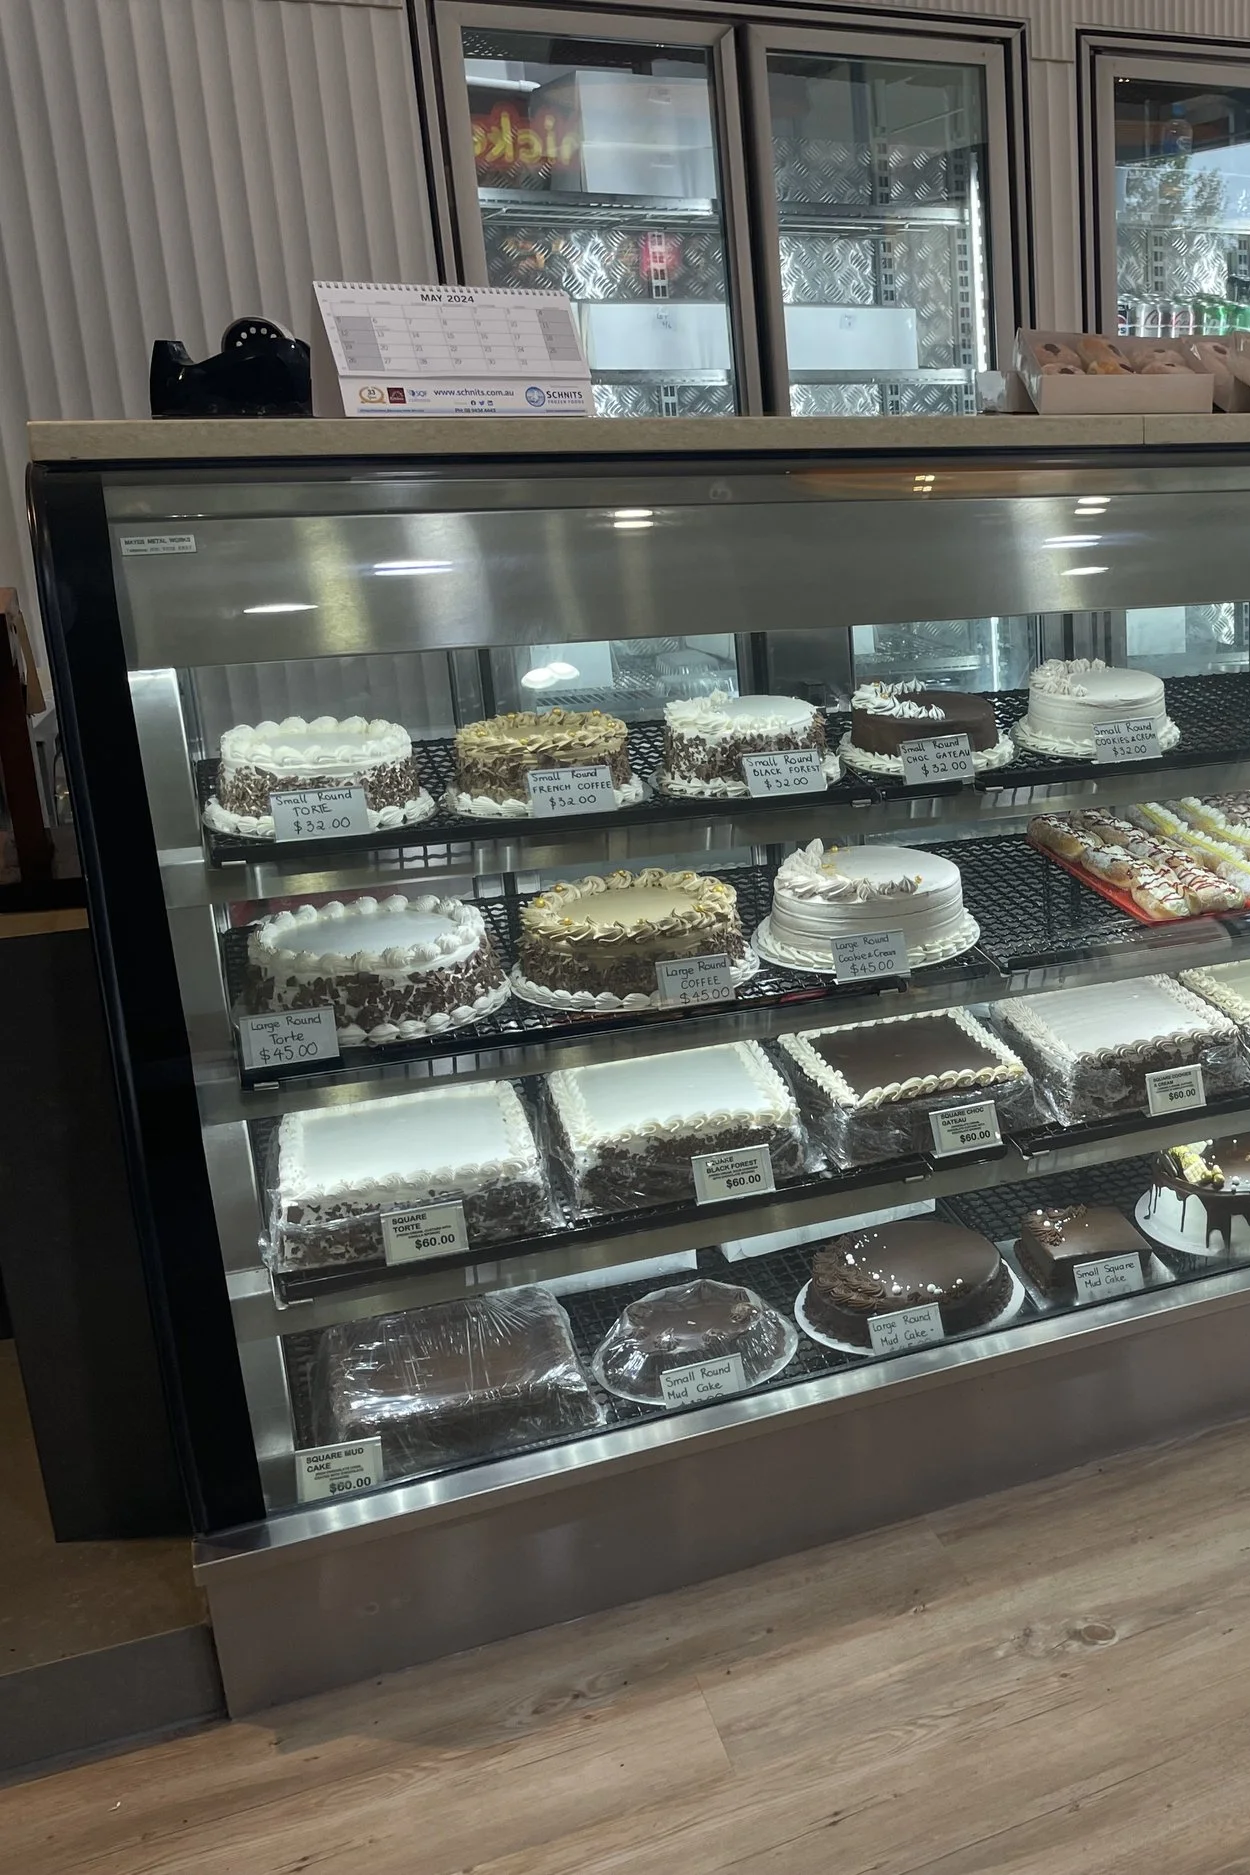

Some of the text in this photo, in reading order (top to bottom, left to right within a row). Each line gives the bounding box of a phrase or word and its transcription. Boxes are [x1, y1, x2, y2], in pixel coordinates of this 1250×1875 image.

[421, 294, 475, 303] MAY 2024
[433, 388, 514, 397] www.schnits.com.au
[546, 390, 583, 399] SCHNITS
[1093, 721, 1152, 735] Small Round
[902, 738, 960, 754] Small Round
[1096, 736, 1130, 746] COOKIES
[1136, 733, 1156, 742] CREAM
[746, 754, 813, 767] Small Round
[907, 750, 971, 764] CHOC GATEAU
[531, 769, 598, 782] Small Round
[753, 764, 820, 777] BLACK FOREST
[532, 781, 612, 794] FRENCH COFFEE
[276, 790, 353, 806] Small Round
[293, 803, 333, 816] TORTE
[835, 935, 889, 953] Large Round
[665, 958, 727, 979] Large Round
[681, 976, 721, 990] COFFEE
[251, 1013, 322, 1033] Large Round
[269, 1031, 305, 1045] Torte
[1168, 1088, 1196, 1101] $60.00
[940, 1106, 985, 1119] SQUARE CHOC
[942, 1117, 967, 1126] GATEAU
[960, 1129, 991, 1144] $60.00
[706, 1165, 730, 1174] BLACK
[731, 1159, 758, 1170] FOREST
[726, 1174, 761, 1190] $60.00
[392, 1213, 427, 1226] SQUARE
[393, 1223, 421, 1234] TORTE
[415, 1233, 455, 1250] $60.00
[1076, 1262, 1135, 1279] Small Square
[1084, 1275, 1126, 1289] Mud Cake
[872, 1312, 931, 1334] Large Round
[880, 1334, 899, 1347] Mud
[904, 1329, 928, 1341] Cake
[665, 1362, 731, 1387] Small Round
[667, 1387, 689, 1400] Mud
[697, 1382, 723, 1393] Cake
[306, 1447, 364, 1464] SQUARE MUD
[307, 1462, 331, 1473] CAKE
[330, 1476, 371, 1495] $60.00
